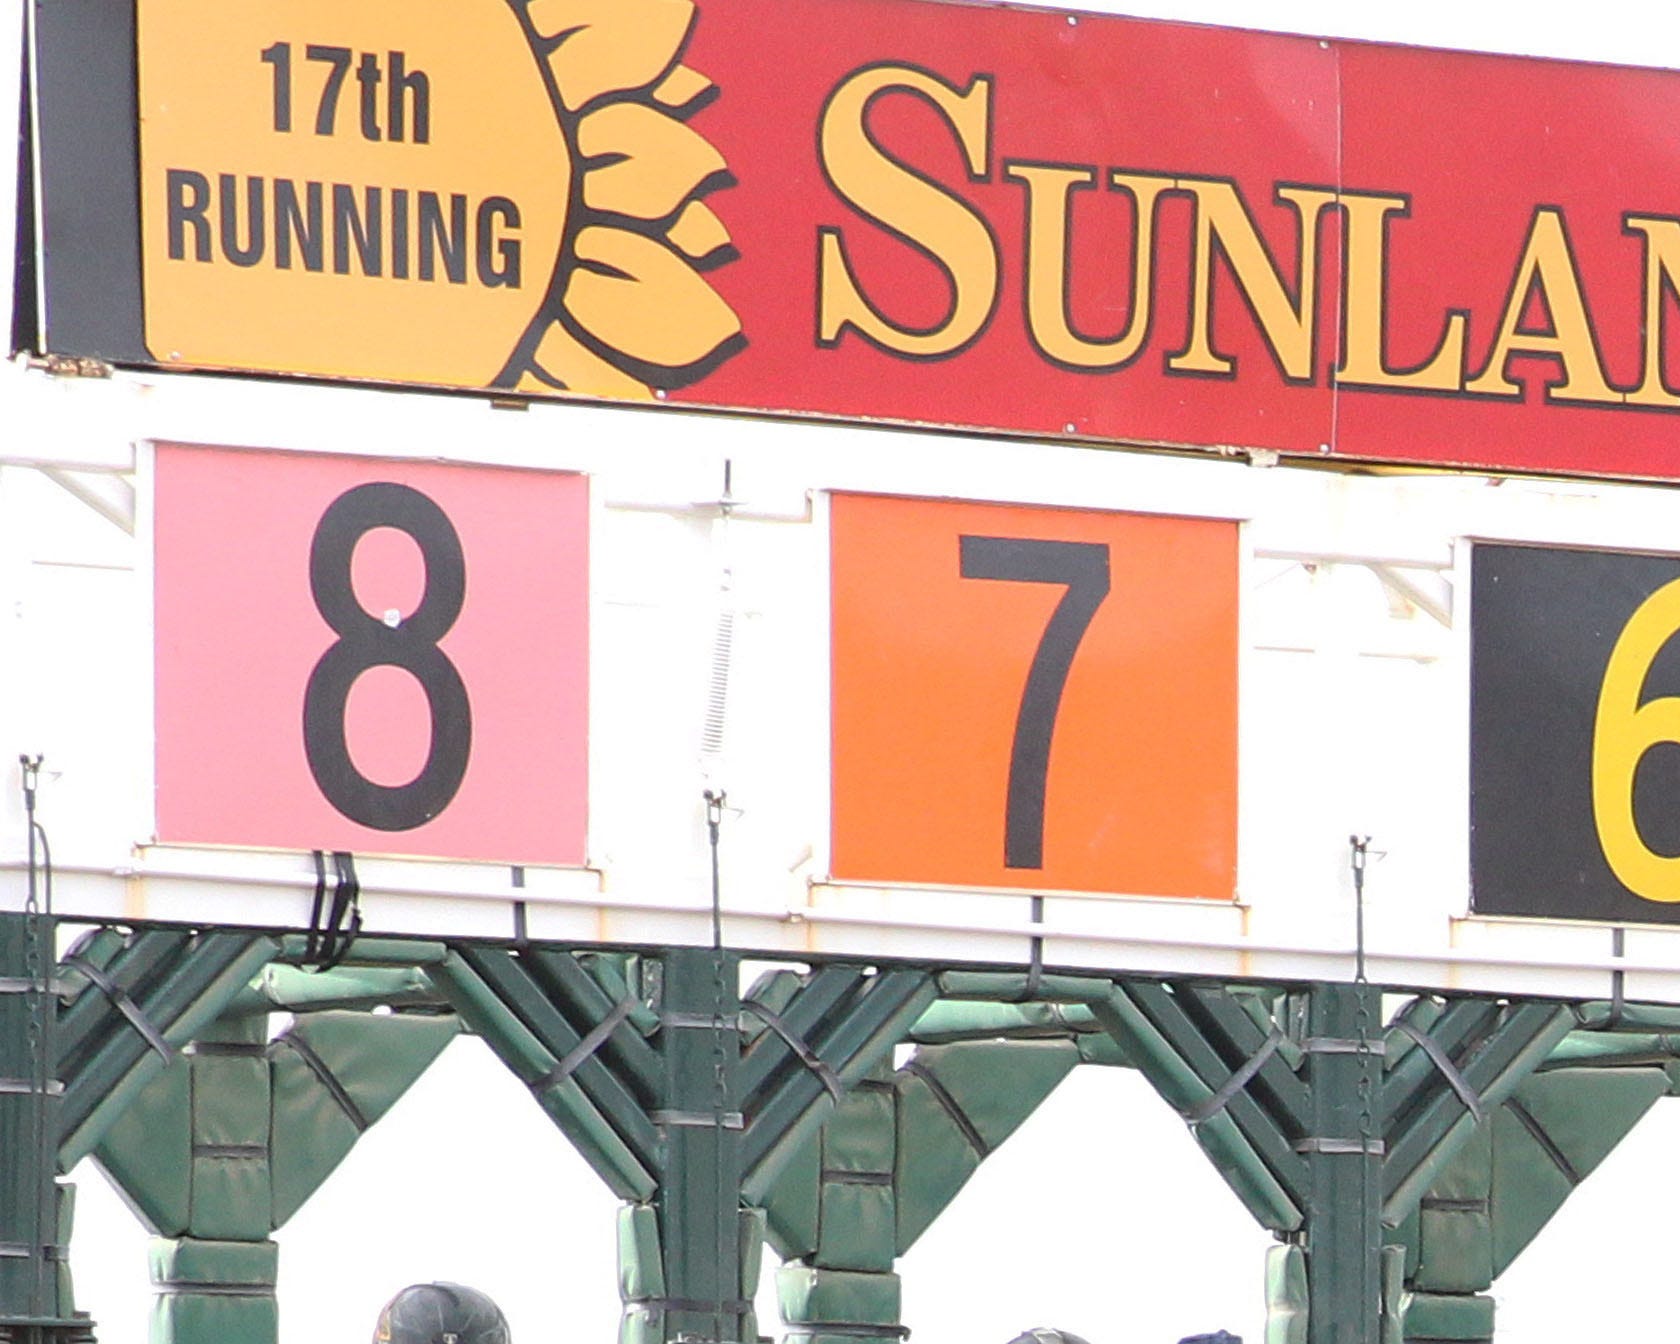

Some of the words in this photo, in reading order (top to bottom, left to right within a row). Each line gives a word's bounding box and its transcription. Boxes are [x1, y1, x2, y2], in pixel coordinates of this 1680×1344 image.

[261, 42, 431, 146] 17th
[166, 168, 523, 290] RUNNING
[304, 483, 471, 833] 8
[960, 534, 1110, 870] 7
